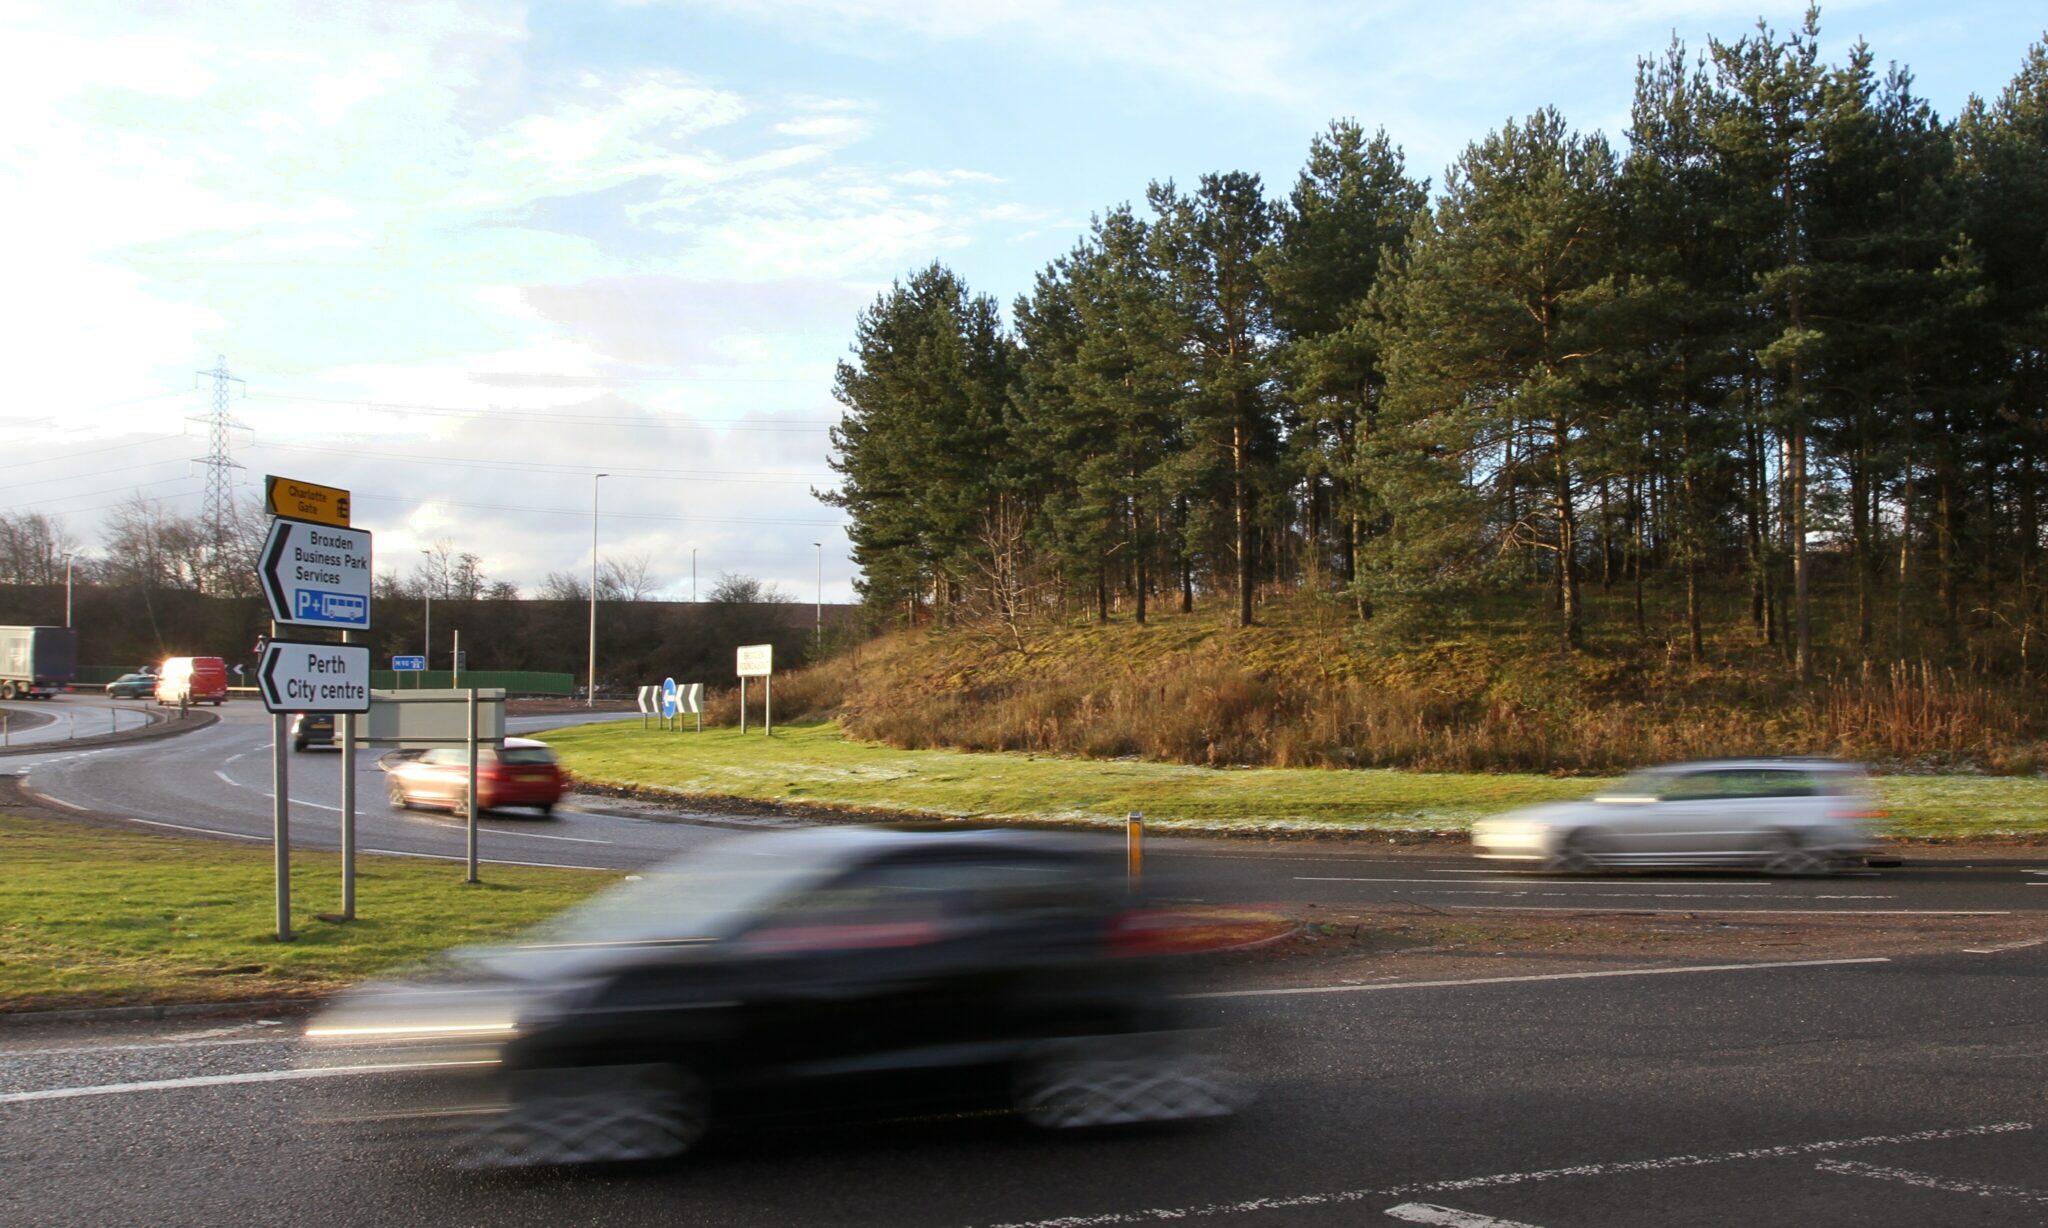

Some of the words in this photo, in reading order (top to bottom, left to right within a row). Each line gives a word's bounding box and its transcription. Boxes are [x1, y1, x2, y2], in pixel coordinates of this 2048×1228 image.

[288, 485, 328, 503] Charlotte
[297, 501, 318, 515] Gate
[310, 531, 353, 550] Broxden
[295, 547, 341, 567] Business
[344, 554, 367, 570] Park
[296, 565, 340, 585] Services
[308, 653, 346, 674] Perth
[287, 678, 316, 703] City
[320, 681, 365, 699] centre
